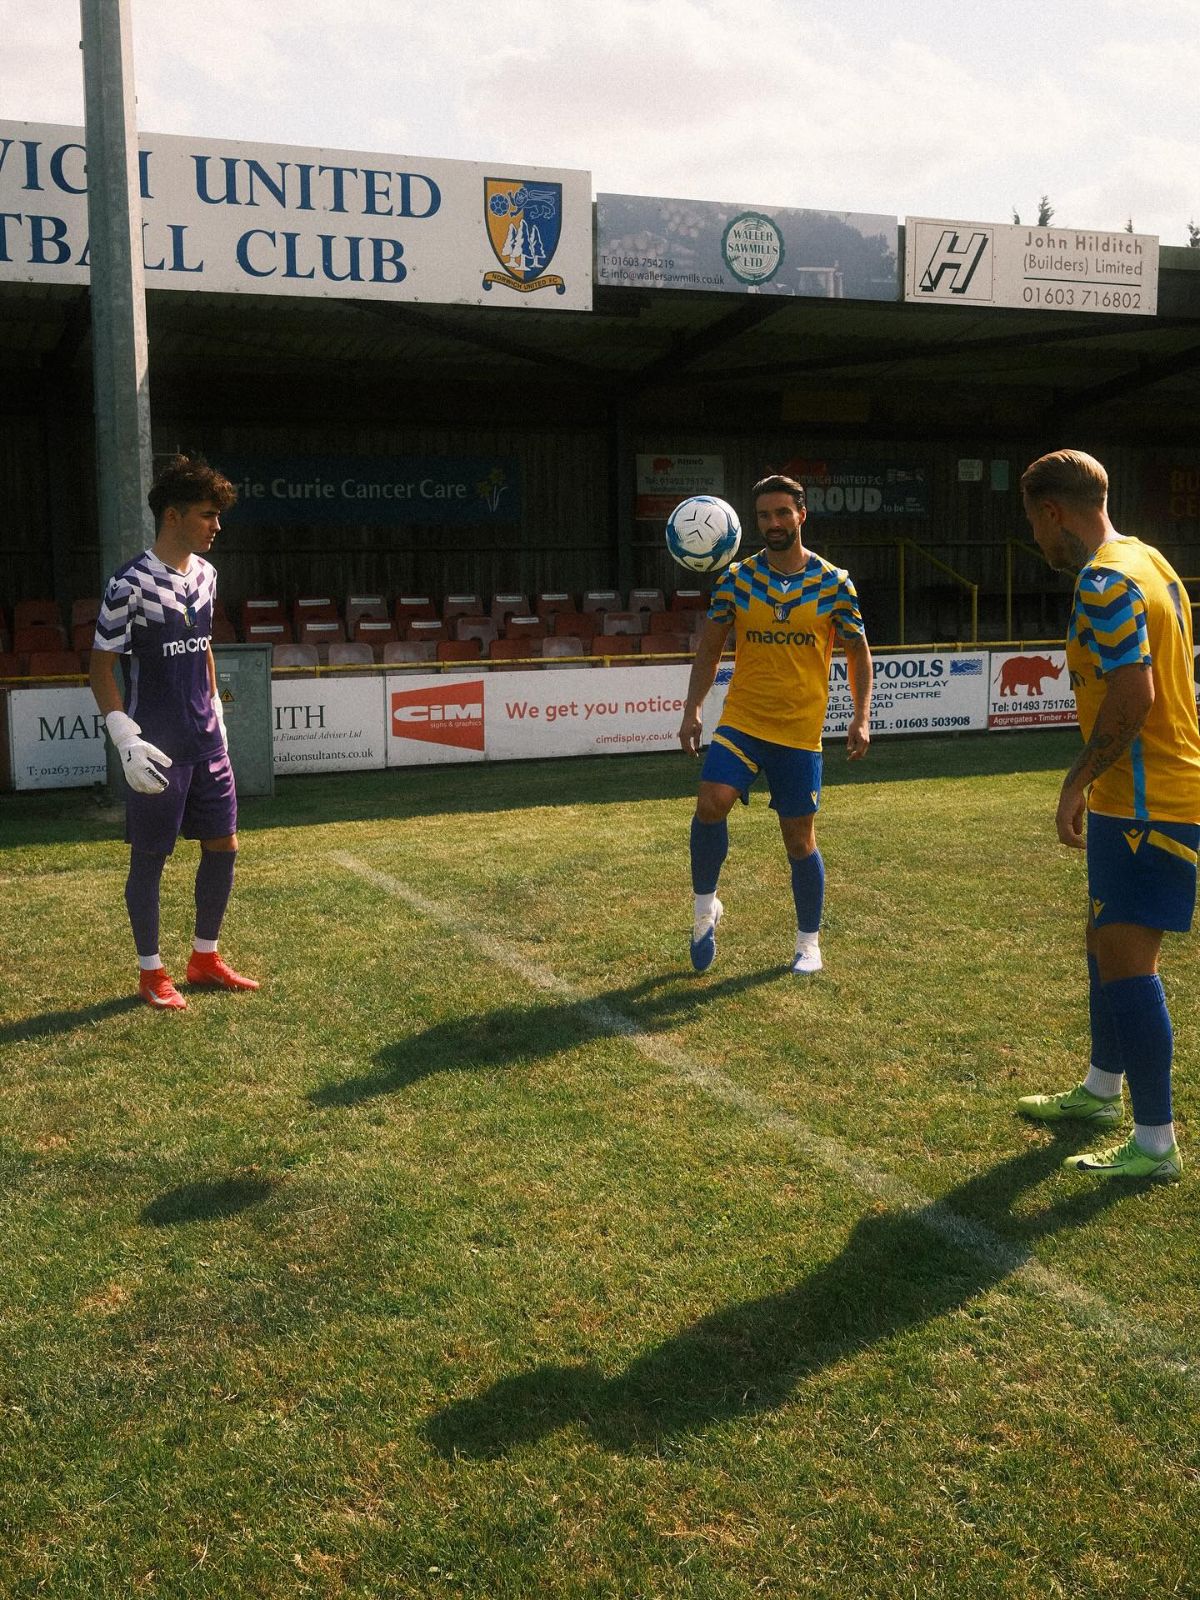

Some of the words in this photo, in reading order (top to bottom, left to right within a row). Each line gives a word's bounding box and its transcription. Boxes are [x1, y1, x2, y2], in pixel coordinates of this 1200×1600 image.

[190, 155, 442, 218] UNITED
[733, 229, 773, 242] WALLER
[1025, 231, 1068, 249] John
[1076, 233, 1142, 255] Hilditch
[236, 229, 408, 284] CLUB
[728, 243, 778, 255] SAWMILLS
[602, 255, 609, 265] T:
[611, 256, 639, 267] 01603
[642, 258, 675, 269] 754219
[744, 257, 763, 267] LTD
[919, 231, 989, 294] H
[1023, 254, 1089, 275] (Builders)
[1095, 258, 1142, 276] Limited
[492, 273, 522, 289] NORWICH
[524, 279, 547, 290] UNITED
[600, 268, 609, 278] E:
[611, 269, 725, 285] info@wallersawmills.co.uk
[1023, 286, 1074, 305] 01603
[1081, 289, 1141, 309] 716802
[271, 477, 335, 498] Curie
[340, 478, 416, 498] Cancer
[419, 478, 467, 498] Care
[833, 475, 866, 485] UNITED
[806, 486, 882, 513] ROUD
[162, 635, 212, 657] macro
[745, 629, 815, 647] macron
[872, 659, 944, 680] POOLS
[881, 681, 897, 689] ON
[900, 679, 949, 689] DISPLAY
[843, 693, 892, 702] GDEN
[895, 691, 942, 700] CENTRE
[992, 702, 1009, 712] Tel:
[1012, 700, 1040, 711] 01493
[1043, 698, 1076, 710] 751762
[274, 705, 326, 730] ITH
[505, 701, 539, 719] We
[546, 701, 578, 721] get
[584, 702, 618, 720] you
[454, 721, 483, 729] graphics
[869, 720, 887, 730] TEL
[895, 718, 928, 729] 01603
[931, 716, 971, 728] 503908
[993, 716, 1033, 725] Aggregates
[280, 732, 317, 742] Financial
[318, 731, 347, 740] Adviser
[348, 730, 362, 739] Ltd
[595, 731, 673, 745] cimdisplay.co.uk
[273, 748, 374, 763] cialconsultants.co.uk
[27, 766, 38, 776] T:
[40, 764, 70, 776] 01263
[145, 767, 168, 788] reusch
